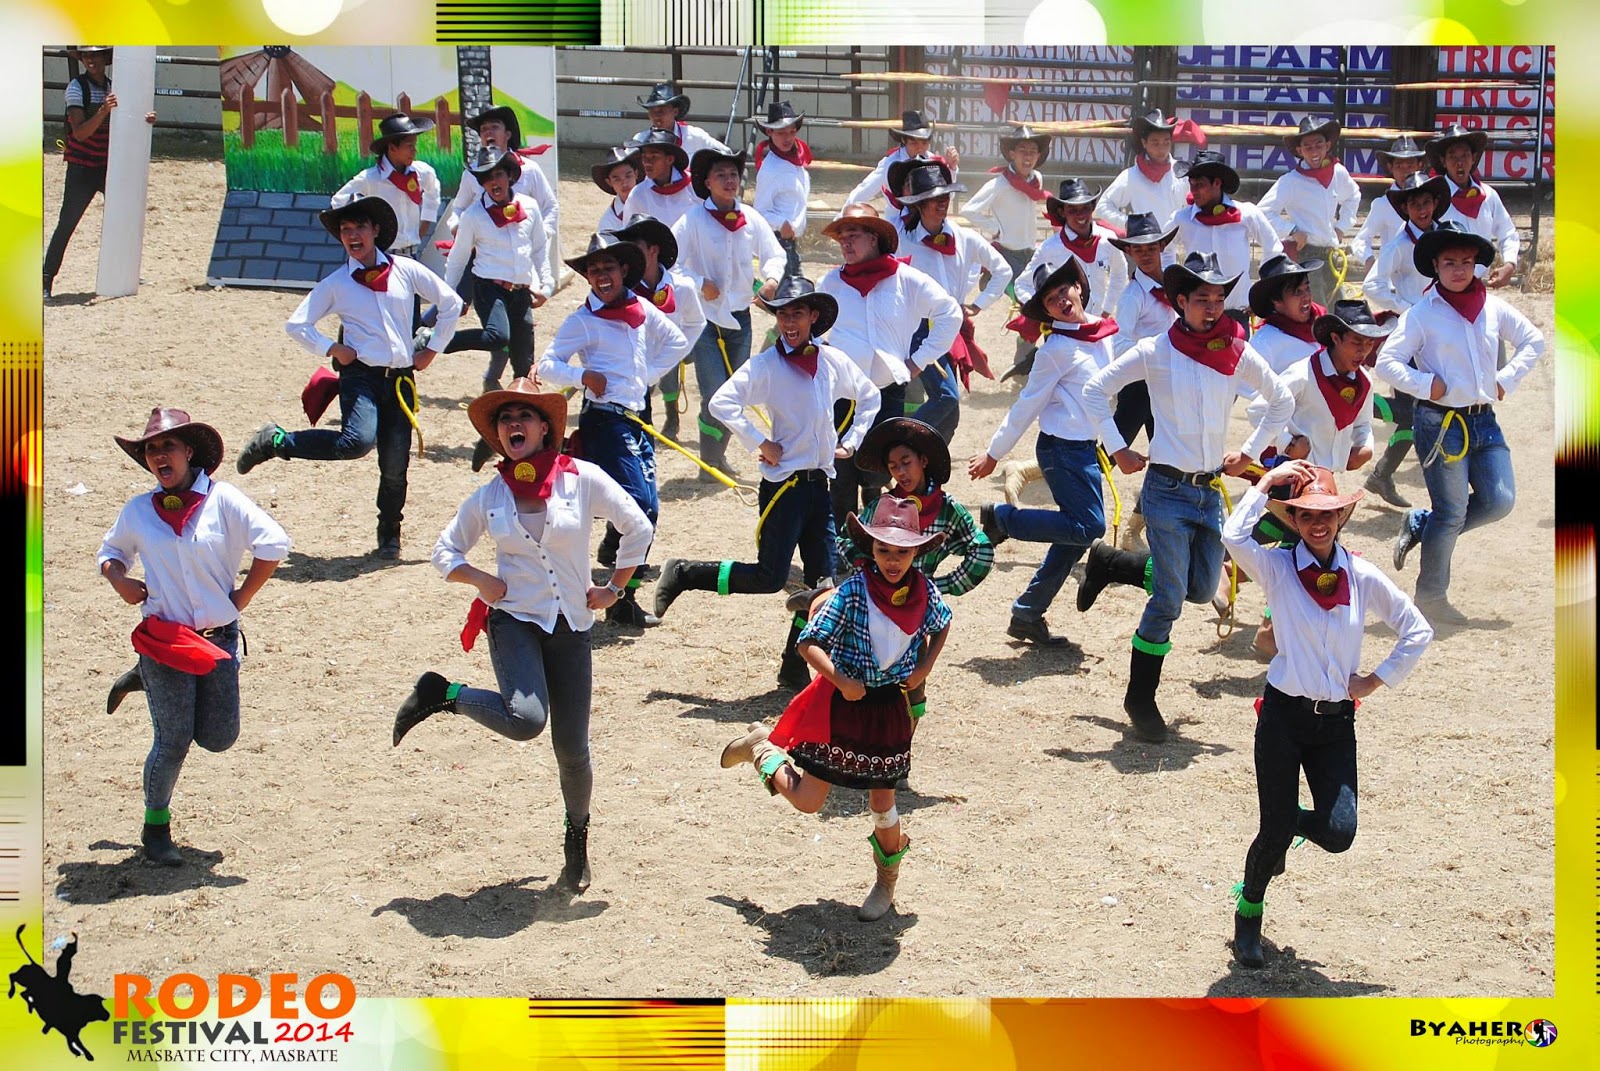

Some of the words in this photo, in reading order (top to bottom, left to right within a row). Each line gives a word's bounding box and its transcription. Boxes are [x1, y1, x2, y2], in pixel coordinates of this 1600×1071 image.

[990, 45, 1134, 64] BRAHMANS
[1178, 45, 1392, 71] JHFARM
[990, 98, 1132, 122] RAHMANS
